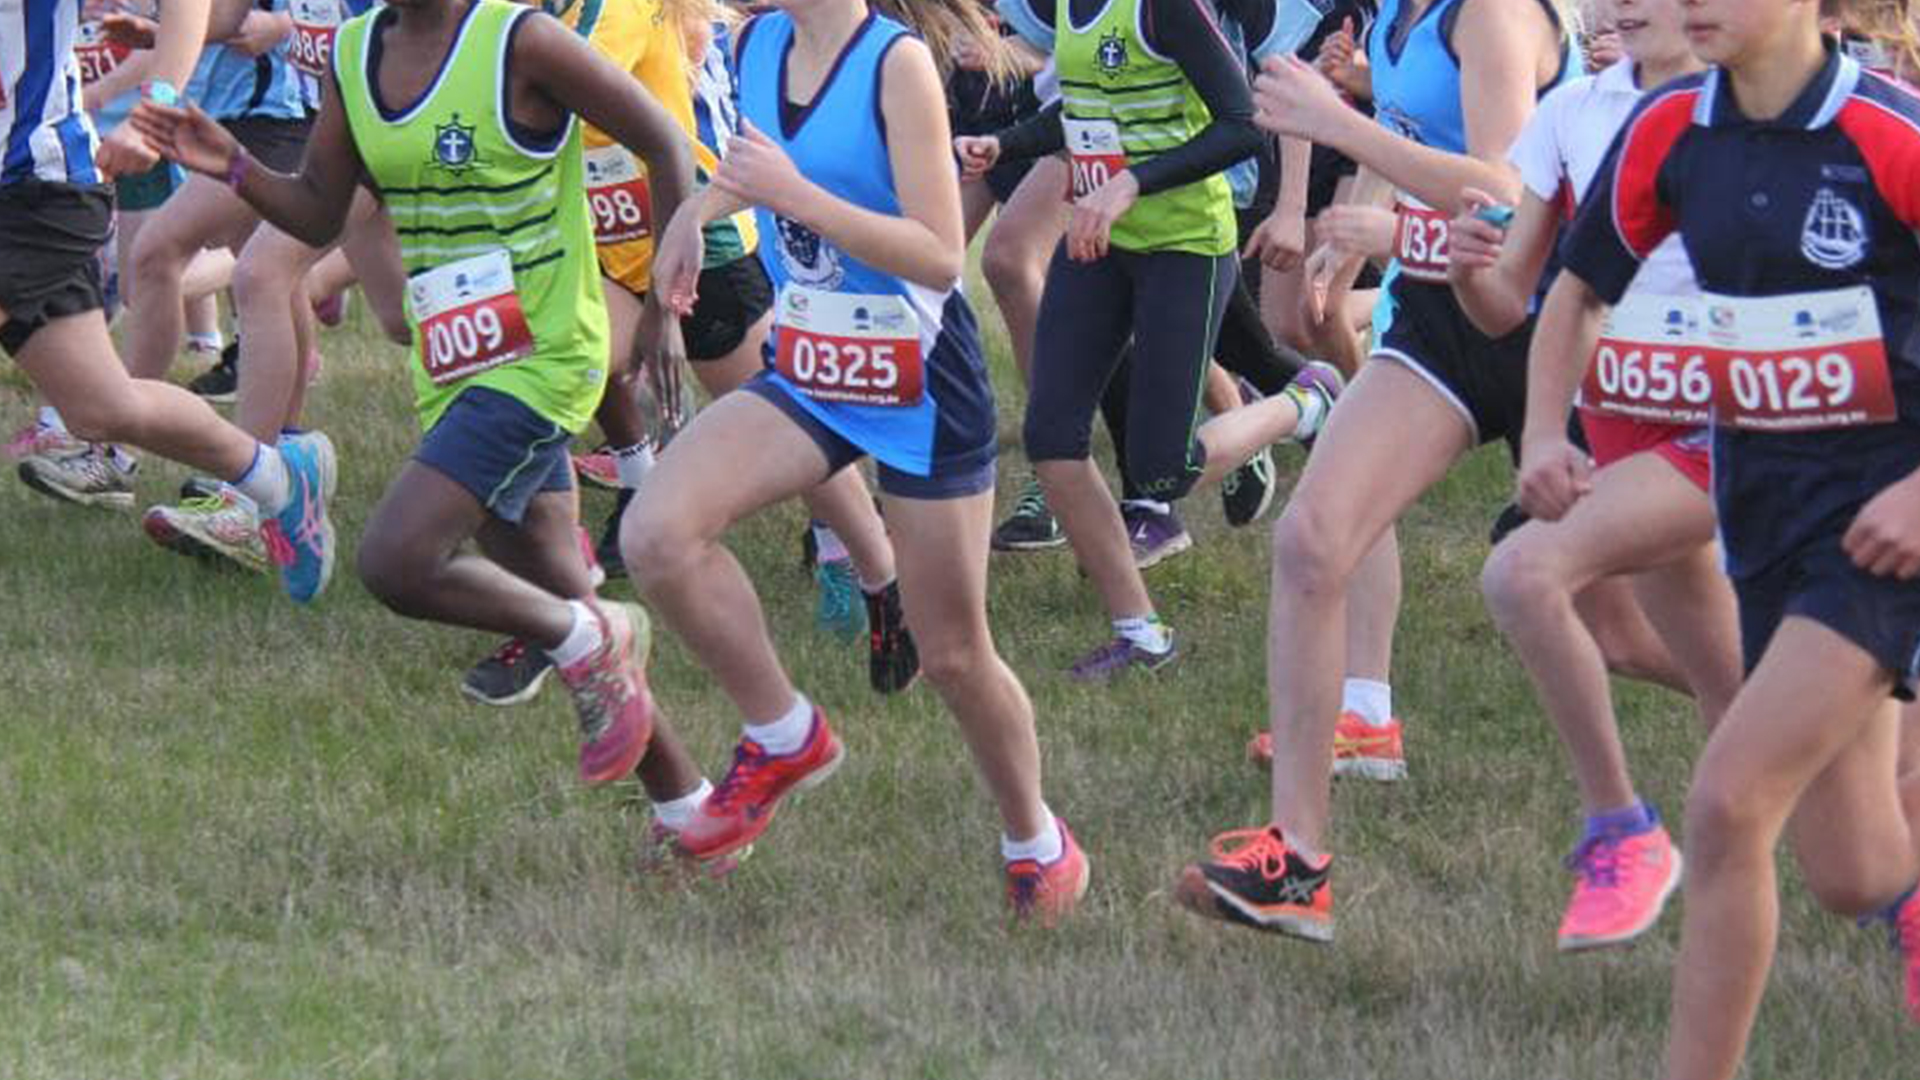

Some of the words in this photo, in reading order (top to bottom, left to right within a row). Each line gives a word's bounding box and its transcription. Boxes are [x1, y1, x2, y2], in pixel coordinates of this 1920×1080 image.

[793, 336, 898, 389] 0325
[1597, 345, 1713, 403] 0656
[1728, 352, 1854, 411] 0129
